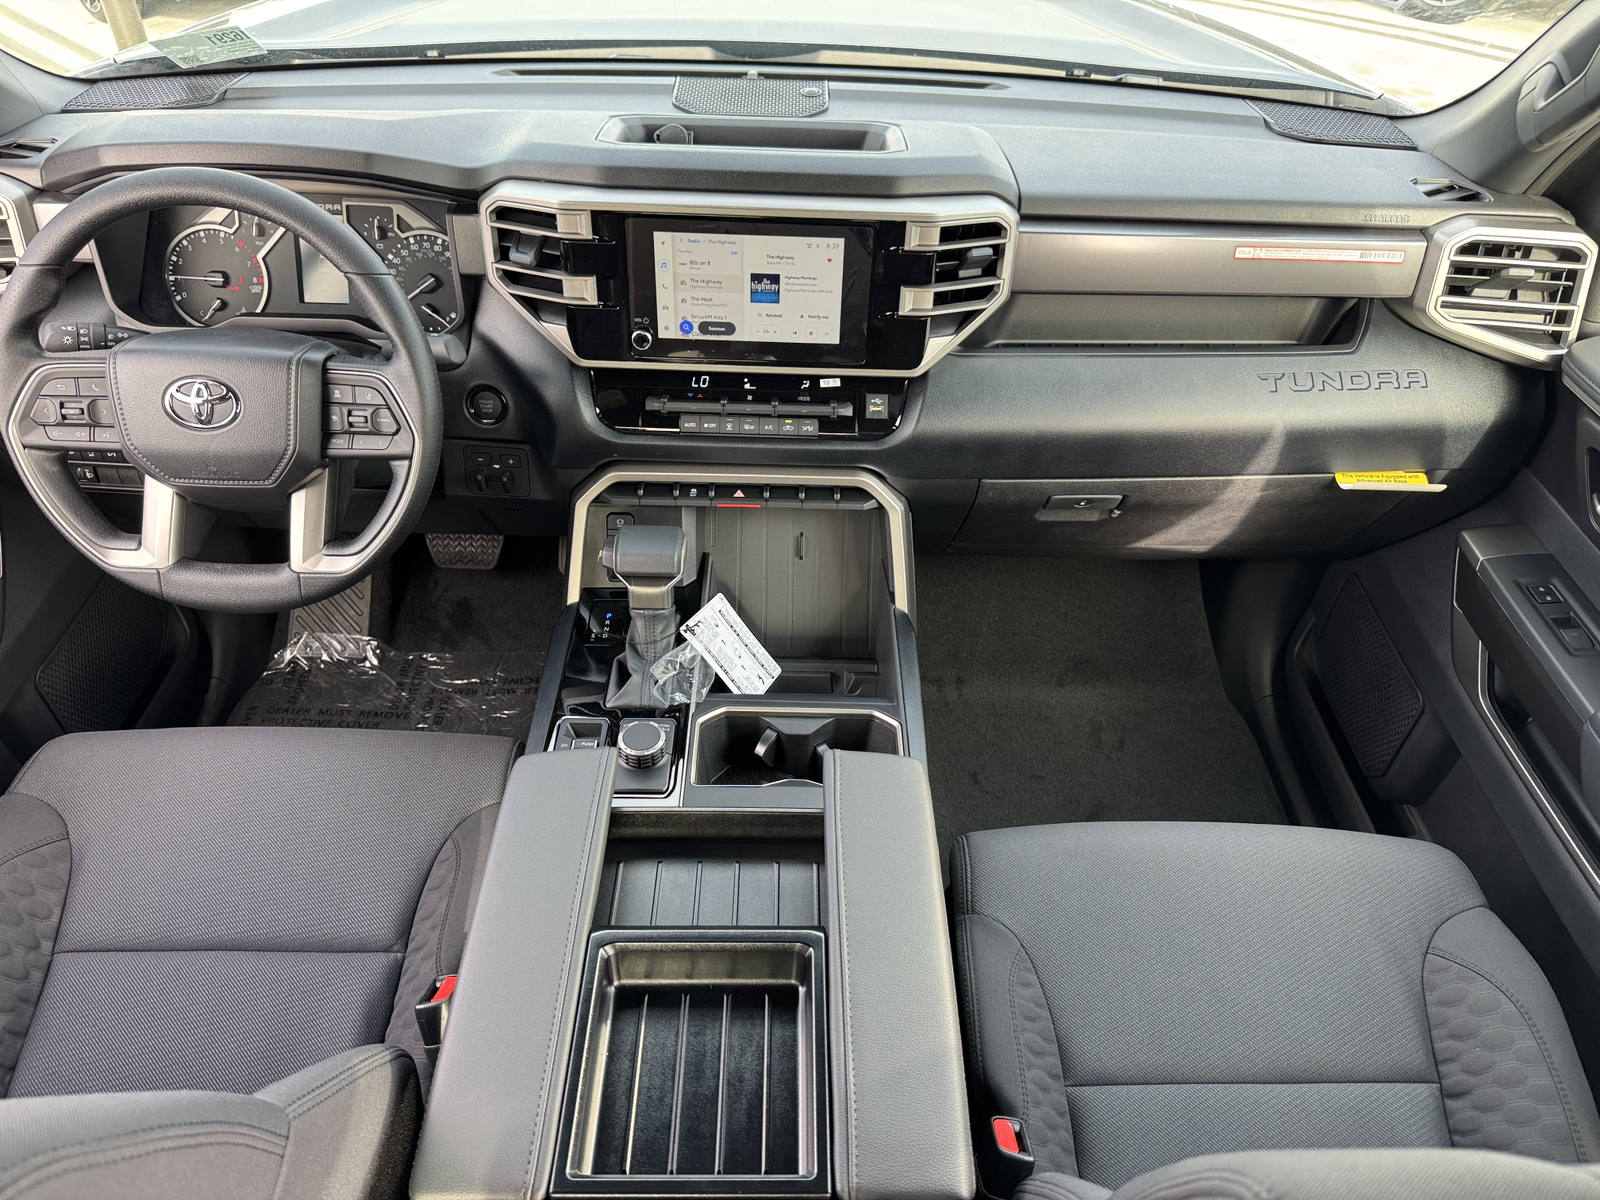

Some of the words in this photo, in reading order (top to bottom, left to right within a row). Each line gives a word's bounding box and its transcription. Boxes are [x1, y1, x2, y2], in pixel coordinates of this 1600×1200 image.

[751, 281, 779, 292] highway
[691, 375, 709, 388] LO
[1257, 369, 1428, 393] TUNDRA
[399, 654, 413, 677] MUS
[502, 677, 540, 685] ECTIVE
[266, 706, 312, 716] DEALER
[318, 708, 352, 718] MUST
[359, 710, 411, 720] REMOVE
[260, 717, 333, 728] PROTECTIVE
[338, 719, 380, 730] COVER
